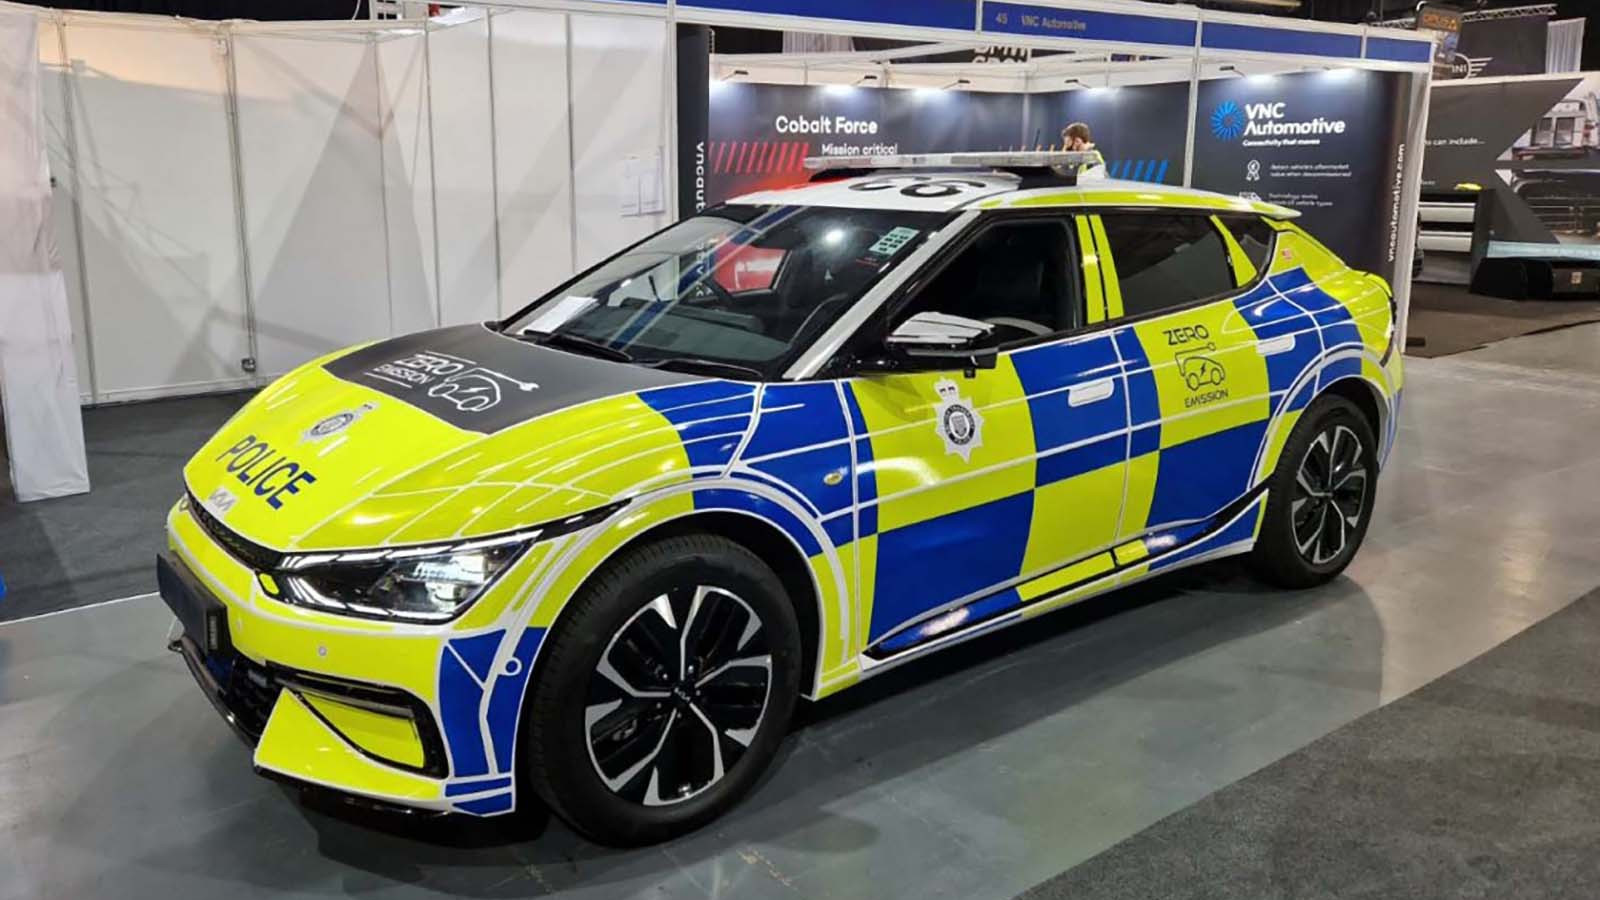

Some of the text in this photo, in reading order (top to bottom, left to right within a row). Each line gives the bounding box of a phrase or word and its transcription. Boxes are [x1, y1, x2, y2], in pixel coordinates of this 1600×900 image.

[1245, 102, 1286, 120] VNC
[775, 115, 878, 134] Cobalt Force
[1243, 117, 1346, 137] Automotive
[821, 143, 899, 156] Mission critical
[1162, 324, 1210, 347] ZERO
[393, 353, 464, 375] ZERO
[1184, 389, 1229, 409] EMISSION
[215, 435, 318, 511] POLICE
